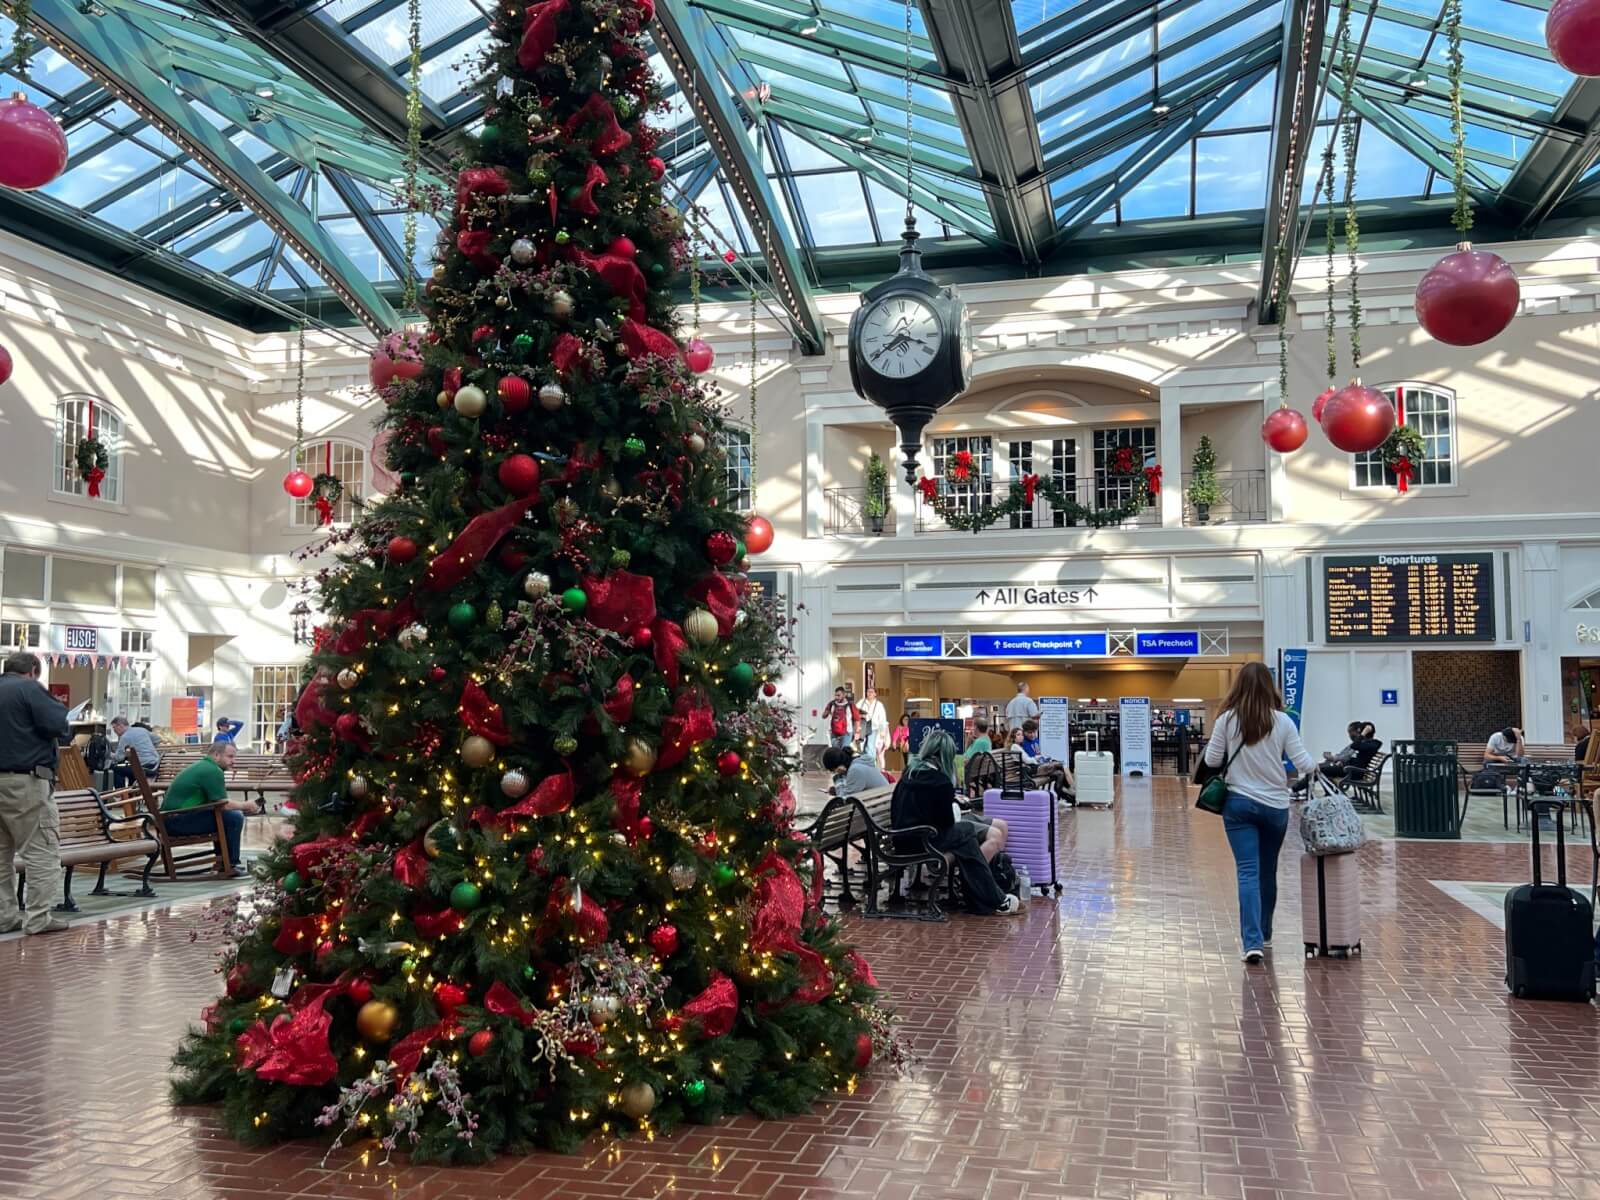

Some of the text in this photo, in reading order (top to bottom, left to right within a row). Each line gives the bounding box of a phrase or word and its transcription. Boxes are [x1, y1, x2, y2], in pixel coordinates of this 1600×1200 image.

[1378, 555, 1438, 565] Departures
[994, 587, 1080, 605] All Gates
[71, 630, 92, 648] USO
[1002, 640, 1073, 650] Security Checkpoint
[1158, 639, 1193, 647] Precheck
[1286, 666, 1297, 705] TSA Pre
